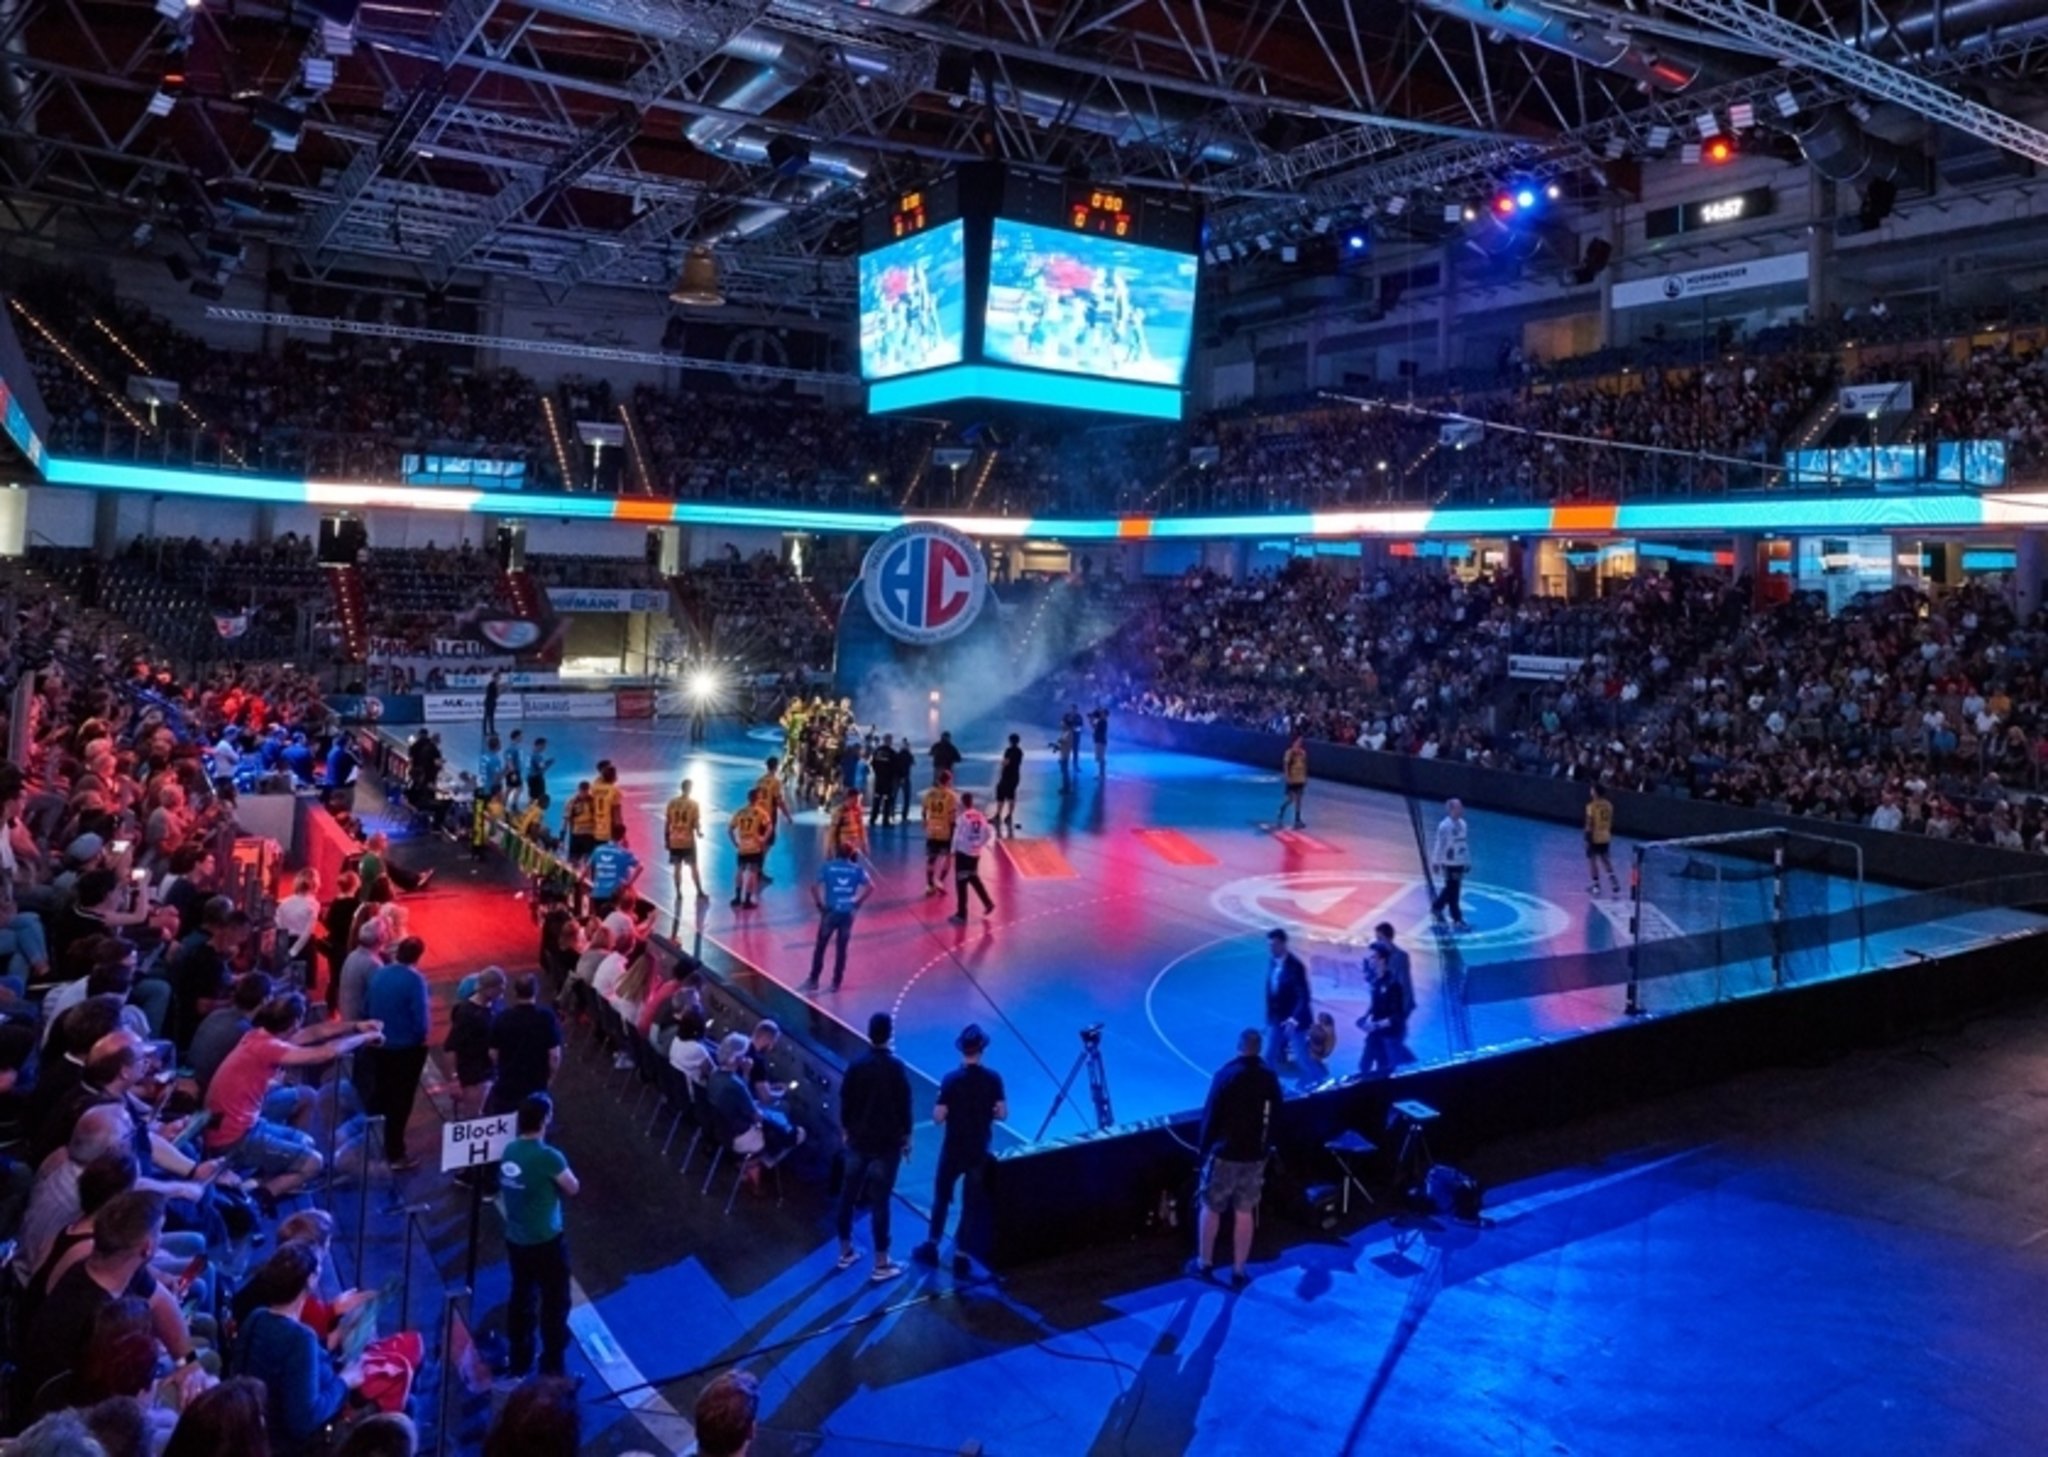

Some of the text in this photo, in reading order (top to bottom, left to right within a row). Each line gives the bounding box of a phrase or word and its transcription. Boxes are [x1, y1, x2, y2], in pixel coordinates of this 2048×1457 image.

[1701, 197, 1745, 223] 14:57
[452, 1119, 509, 1143] Block
[468, 1140, 490, 1164] H
